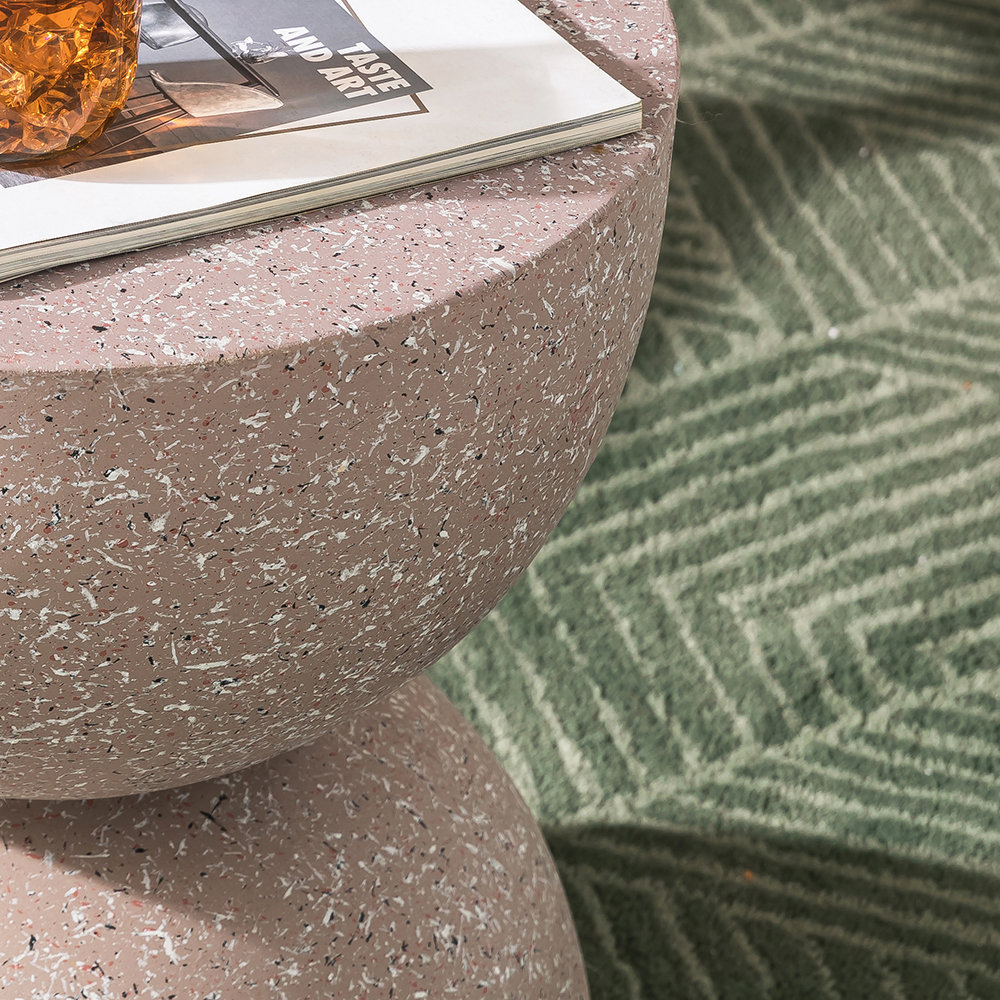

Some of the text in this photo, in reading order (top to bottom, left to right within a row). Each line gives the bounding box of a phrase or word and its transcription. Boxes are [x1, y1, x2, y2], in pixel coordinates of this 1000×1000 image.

[273, 26, 379, 99] AND ART
[337, 42, 412, 93] TASTE
